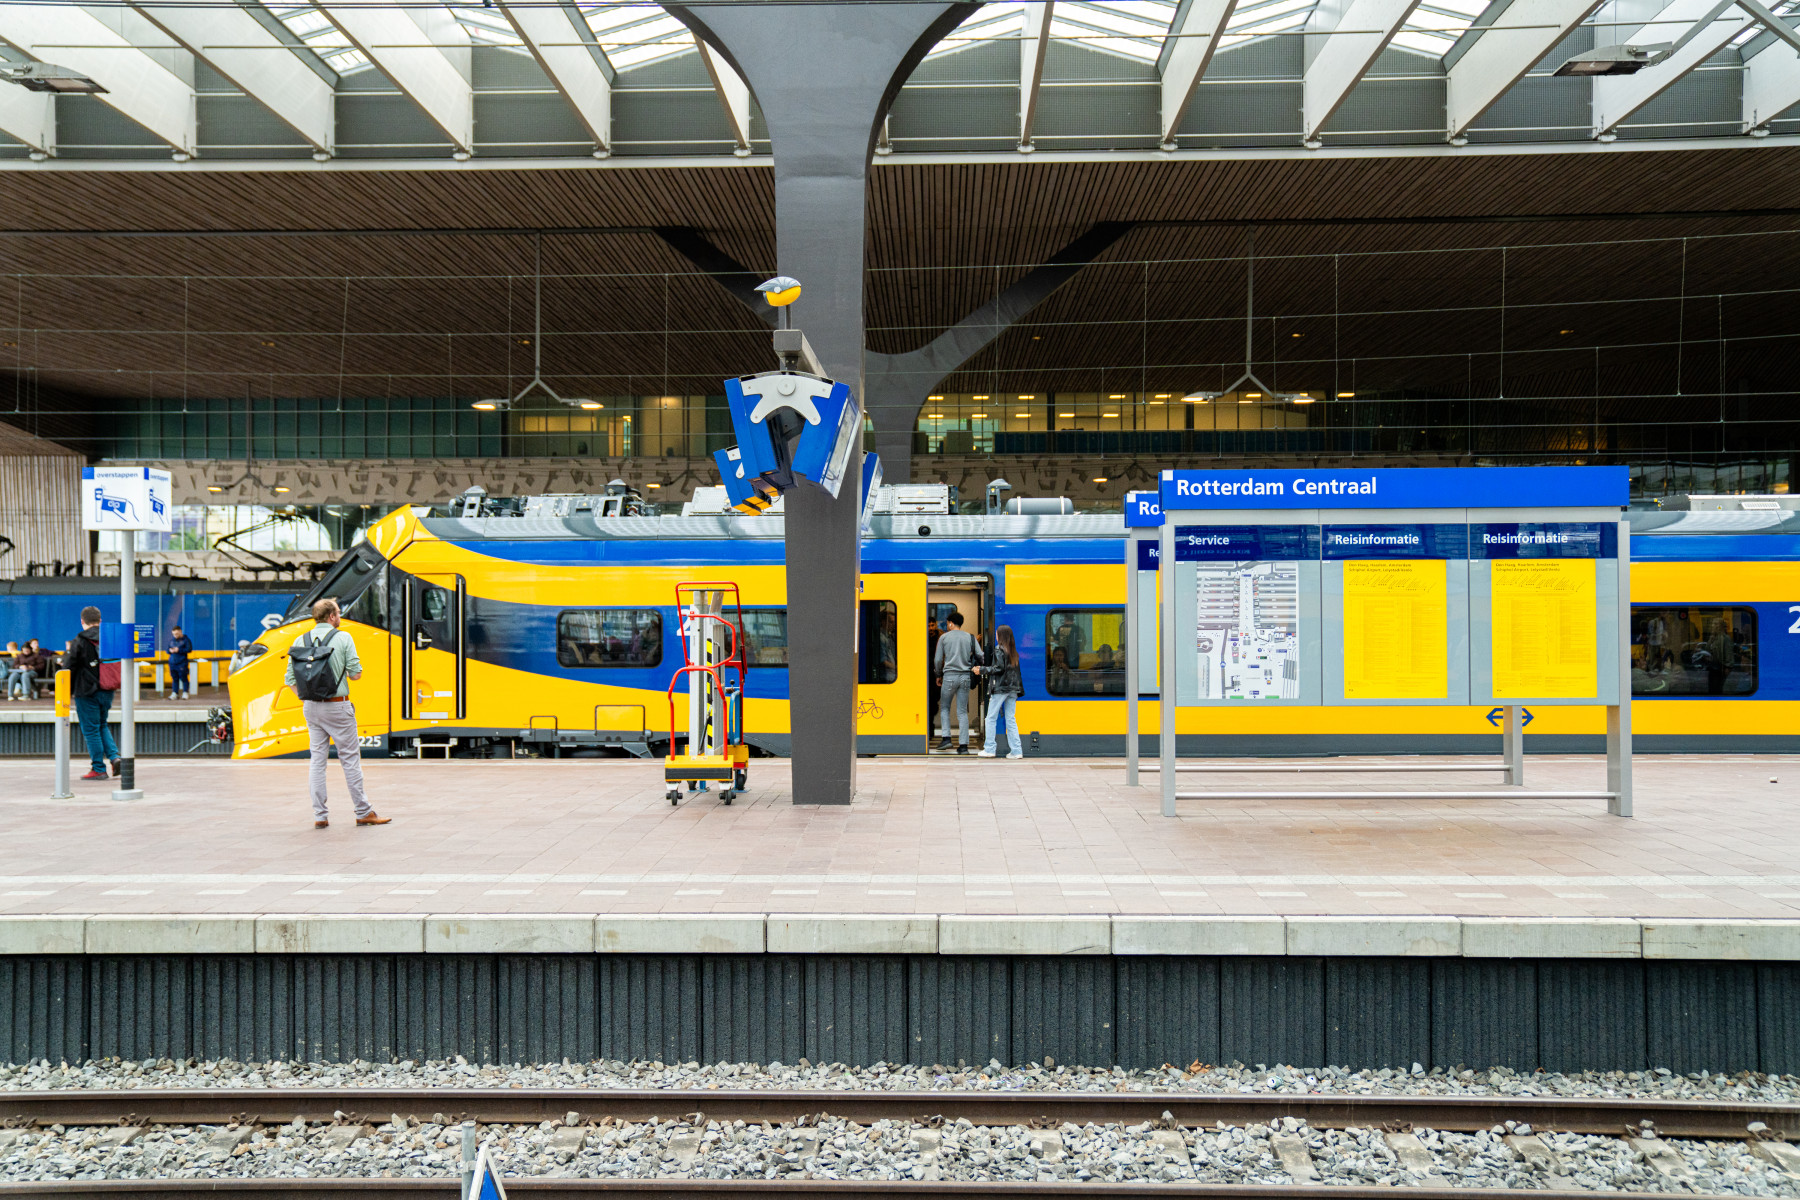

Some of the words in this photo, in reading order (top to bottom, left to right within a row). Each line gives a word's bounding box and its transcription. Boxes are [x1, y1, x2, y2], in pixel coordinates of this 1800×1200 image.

[1177, 477, 1284, 496] Rotterdam
[1292, 476, 1377, 495] Centraal
[1139, 501, 1165, 515] Ro
[1188, 534, 1230, 545] Service
[1335, 533, 1420, 545] Reisinformatie
[1483, 532, 1568, 544] Reisinformatie
[1788, 605, 1800, 634] 2
